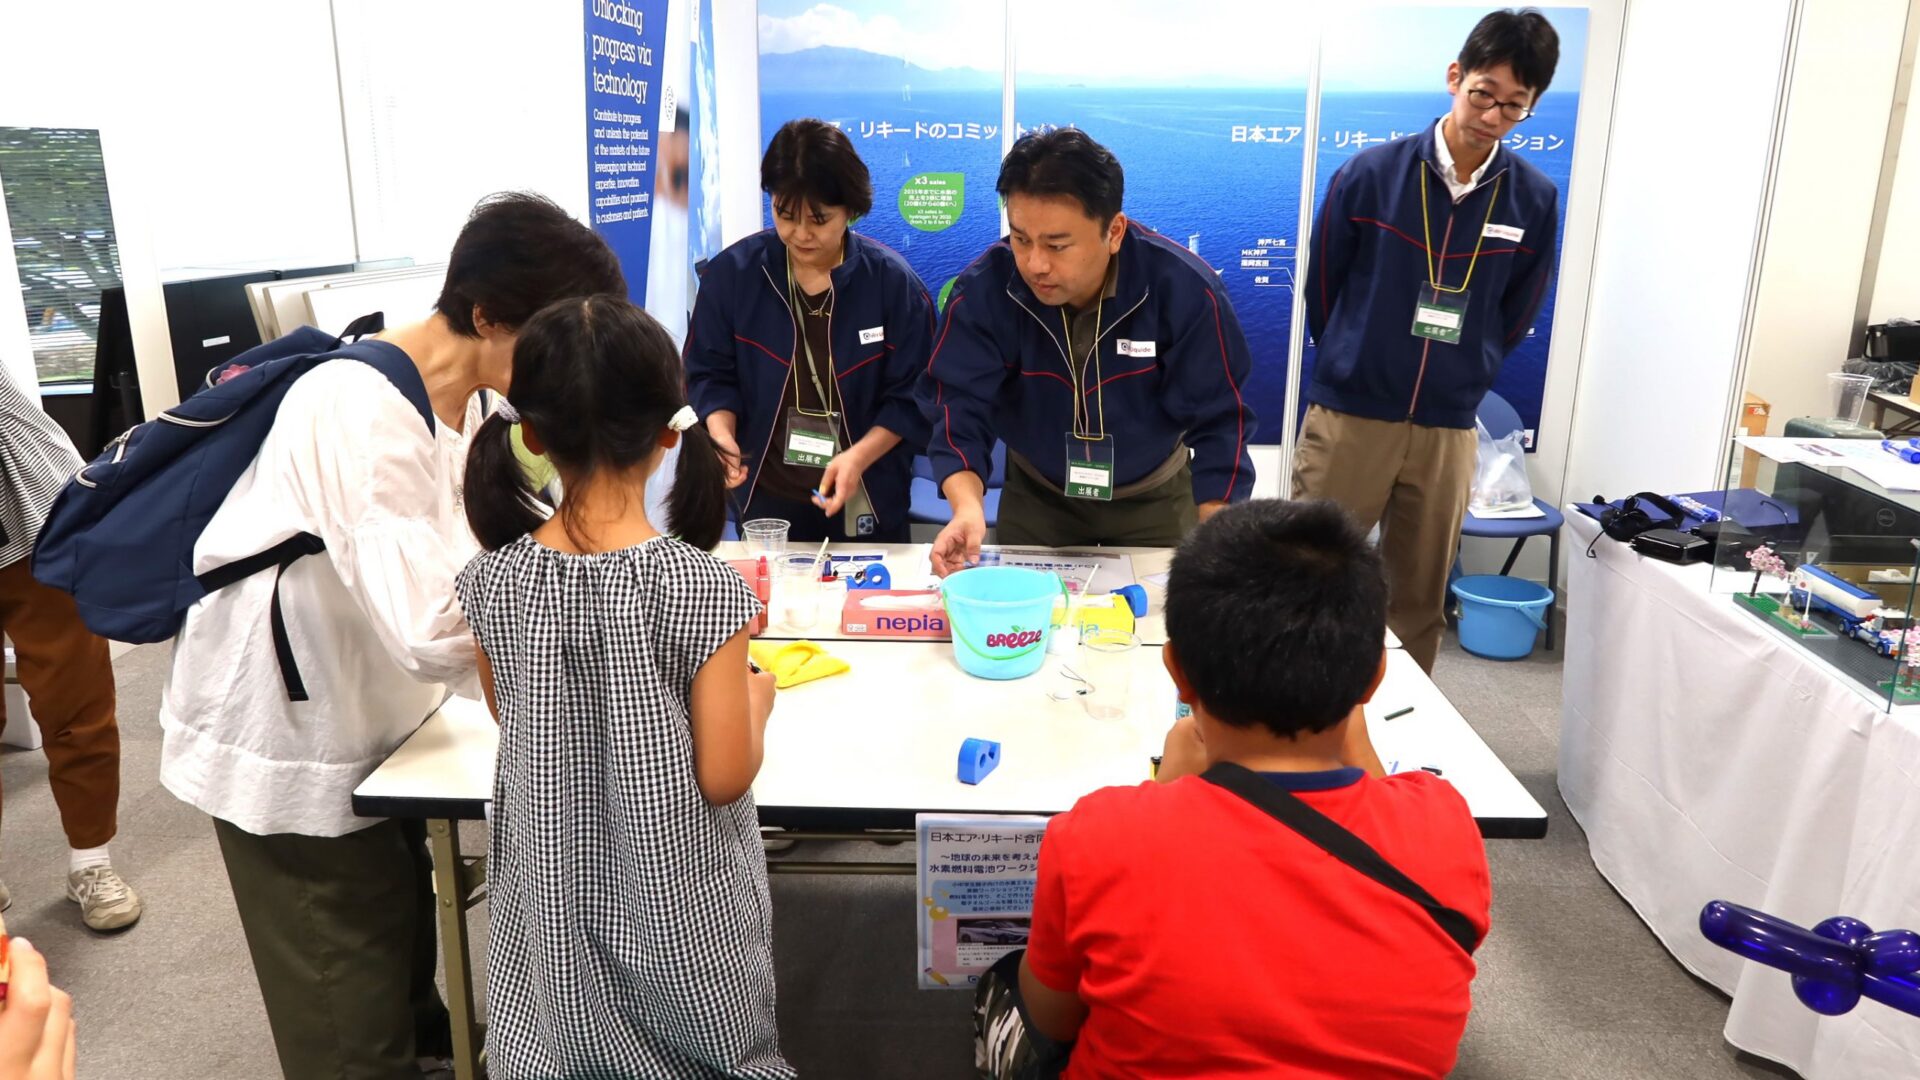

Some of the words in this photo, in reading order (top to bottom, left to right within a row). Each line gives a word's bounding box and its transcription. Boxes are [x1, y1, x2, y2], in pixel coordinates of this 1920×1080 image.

[593, 0, 643, 35] Unlocking
[592, 34, 636, 65] progress
[637, 42, 652, 66] via
[593, 66, 648, 104] technology
[593, 108, 617, 121] Contribute
[618, 111, 622, 122] to
[623, 113, 642, 126] progress
[594, 126, 605, 138] and
[605, 126, 622, 139] unleash
[622, 127, 630, 139] the
[630, 129, 649, 141] potential
[1231, 125, 1302, 143] 日本エア
[594, 144, 599, 156] of
[600, 144, 609, 156] the
[609, 144, 625, 156] markets
[638, 147, 650, 156] future
[594, 161, 619, 175] leveraging
[619, 163, 627, 172] our
[627, 160, 647, 172] technical
[595, 178, 616, 192] expertise,
[616, 176, 640, 189] innovation
[914, 176, 928, 185] x3
[595, 193, 620, 209] capabilities
[620, 192, 630, 204] and
[630, 192, 649, 206] proximity
[595, 212, 601, 224] to
[601, 210, 623, 224] customers
[623, 209, 632, 220] and
[797, 453, 821, 464] 出展者
[1078, 486, 1101, 497] 出展者
[876, 614, 943, 632] nepia
